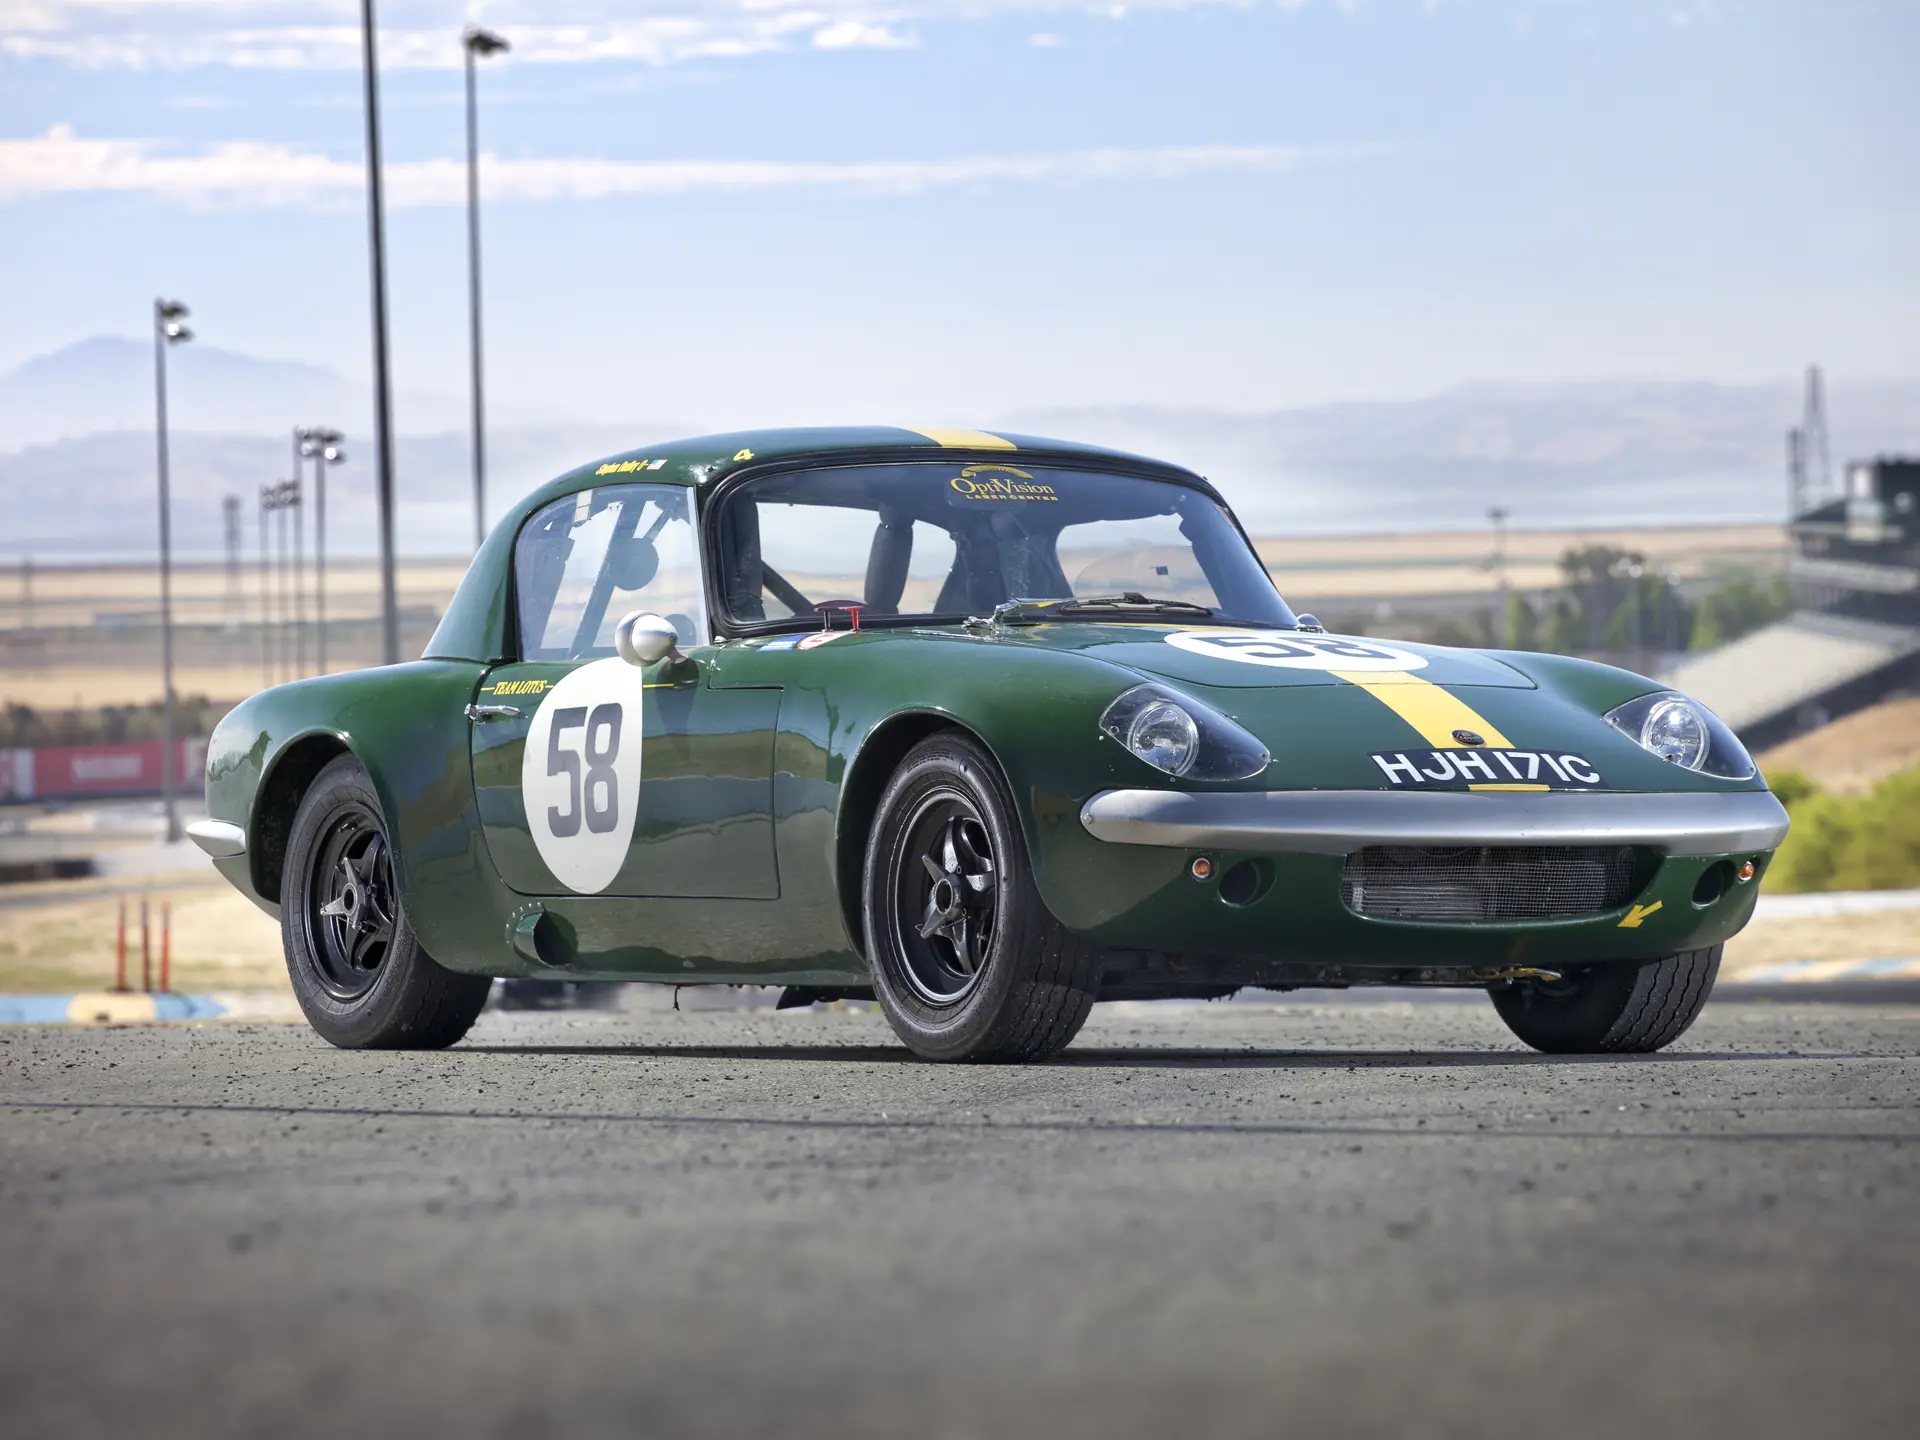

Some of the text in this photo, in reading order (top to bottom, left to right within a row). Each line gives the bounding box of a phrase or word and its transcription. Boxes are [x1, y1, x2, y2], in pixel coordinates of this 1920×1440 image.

[733, 449, 755, 461] 4
[950, 478, 1054, 495] OptiVision
[493, 680, 548, 695] TEAM LOTUS
[547, 702, 623, 838] 58
[1371, 751, 1600, 784] HJH 171C
